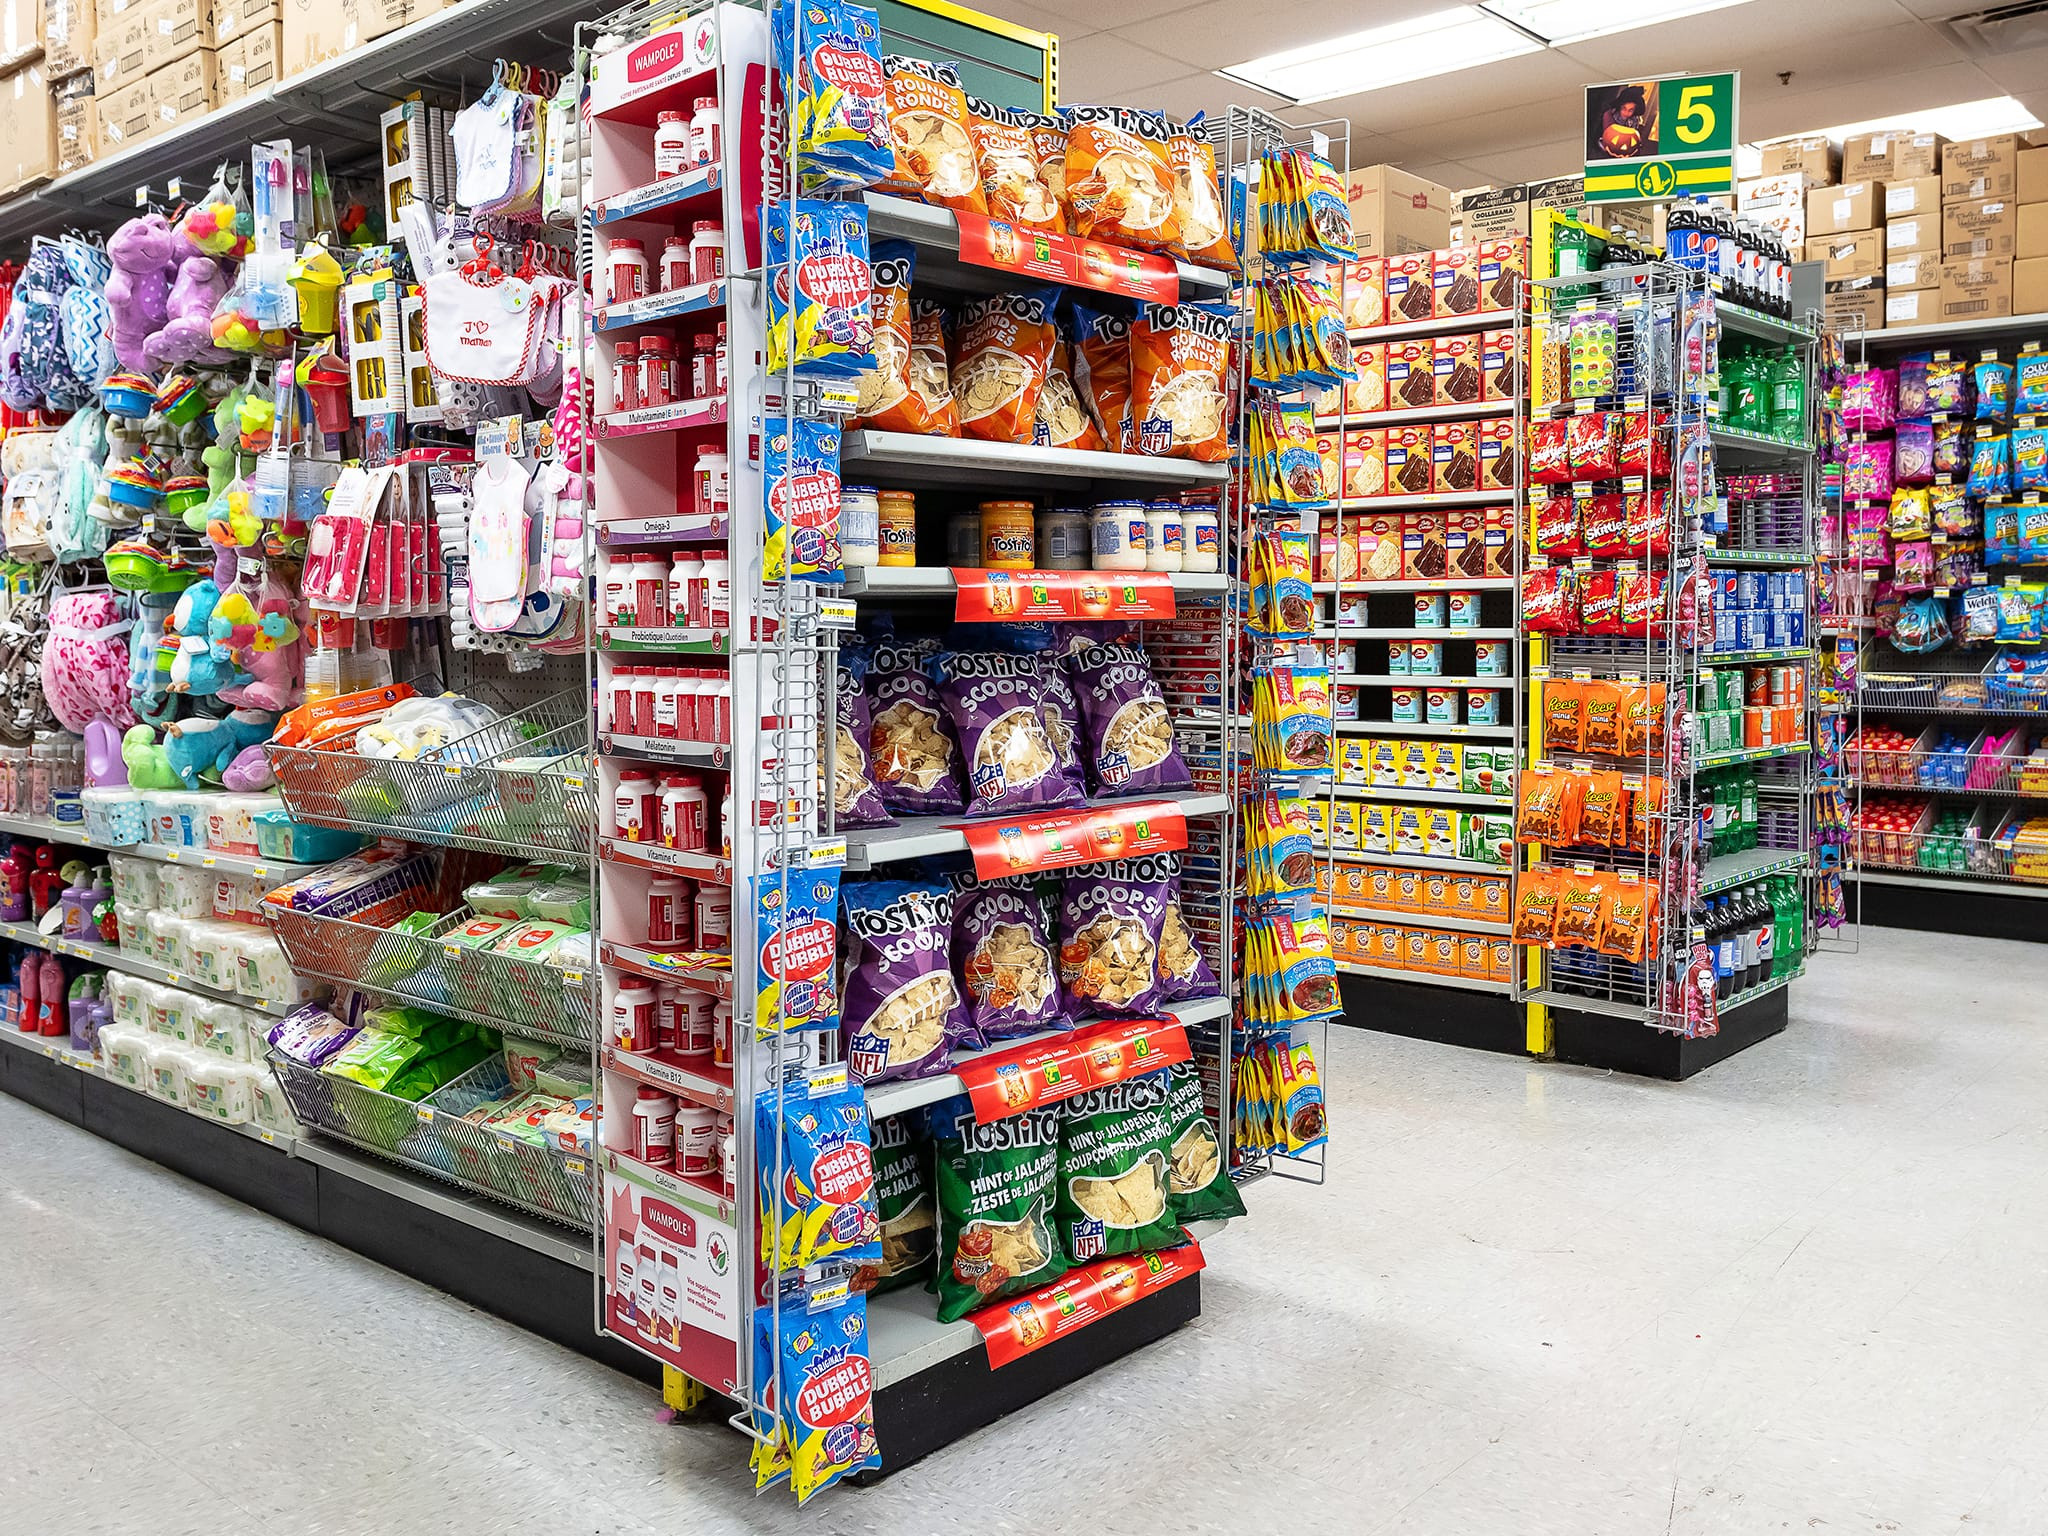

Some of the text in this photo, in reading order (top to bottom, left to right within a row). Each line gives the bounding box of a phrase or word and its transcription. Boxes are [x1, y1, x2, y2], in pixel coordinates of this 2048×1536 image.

[819, 50, 879, 75] DUBBLE
[822, 66, 882, 88] BUBBLE
[893, 79, 958, 107] ROUNDS
[895, 94, 961, 120] RONDES
[1675, 85, 1715, 144] 5
[666, 180, 684, 194] Femme
[1476, 208, 1513, 218] DOLLARAMA
[805, 260, 868, 280] DUBBLE
[810, 277, 870, 298] BUBBLE
[966, 316, 1018, 339] ROUNDS
[460, 336, 492, 347] maman
[961, 328, 1014, 352] RONDES
[1170, 335, 1224, 359] ROUNDS
[1171, 350, 1221, 371] RONDES
[629, 410, 666, 424] Multivitamine
[1142, 433, 1169, 453] NFL
[1570, 439, 1608, 458] Skittles
[1620, 437, 1650, 451] Skittle
[2016, 434, 2043, 448] JOLLY
[644, 520, 671, 533] Oméga-3
[1537, 523, 1577, 540] Skittles
[1586, 522, 1628, 539] Skittles
[828, 608, 844, 616] $1.00
[1582, 596, 1620, 615] Skittles
[632, 630, 688, 647] Probiotique Quotidien
[1548, 699, 1579, 712] Reese
[1586, 702, 1617, 714] Reese
[1628, 702, 1663, 717] Reese
[645, 740, 676, 753] Mélatonine
[1102, 766, 1129, 784] NFL
[977, 782, 1004, 800] NFL
[1585, 790, 1613, 802] Reese
[647, 849, 677, 863] Vitamine C
[818, 848, 835, 857] $1.00
[1523, 894, 1556, 906] Reese
[1564, 890, 1600, 903] Reese
[769, 925, 833, 959] DUBBLE
[852, 1050, 886, 1074] NFL
[645, 1063, 682, 1084] Vitamine B12
[817, 1077, 834, 1086] $1.00
[1069, 1111, 1157, 1152] HINT OF JALAPEÑO
[881, 1157, 919, 1181] JALAP
[655, 1174, 677, 1192] Calcium
[970, 1173, 1002, 1194] HINT
[1003, 1170, 1014, 1181] OF
[972, 1190, 1010, 1215] ZESTE
[1011, 1187, 1022, 1198] DE
[1076, 1238, 1104, 1259] NFL
[811, 1353, 844, 1378] ORIGINAL
[803, 1360, 867, 1407] DUBBLE
[810, 1377, 871, 1422] BUBBLE
